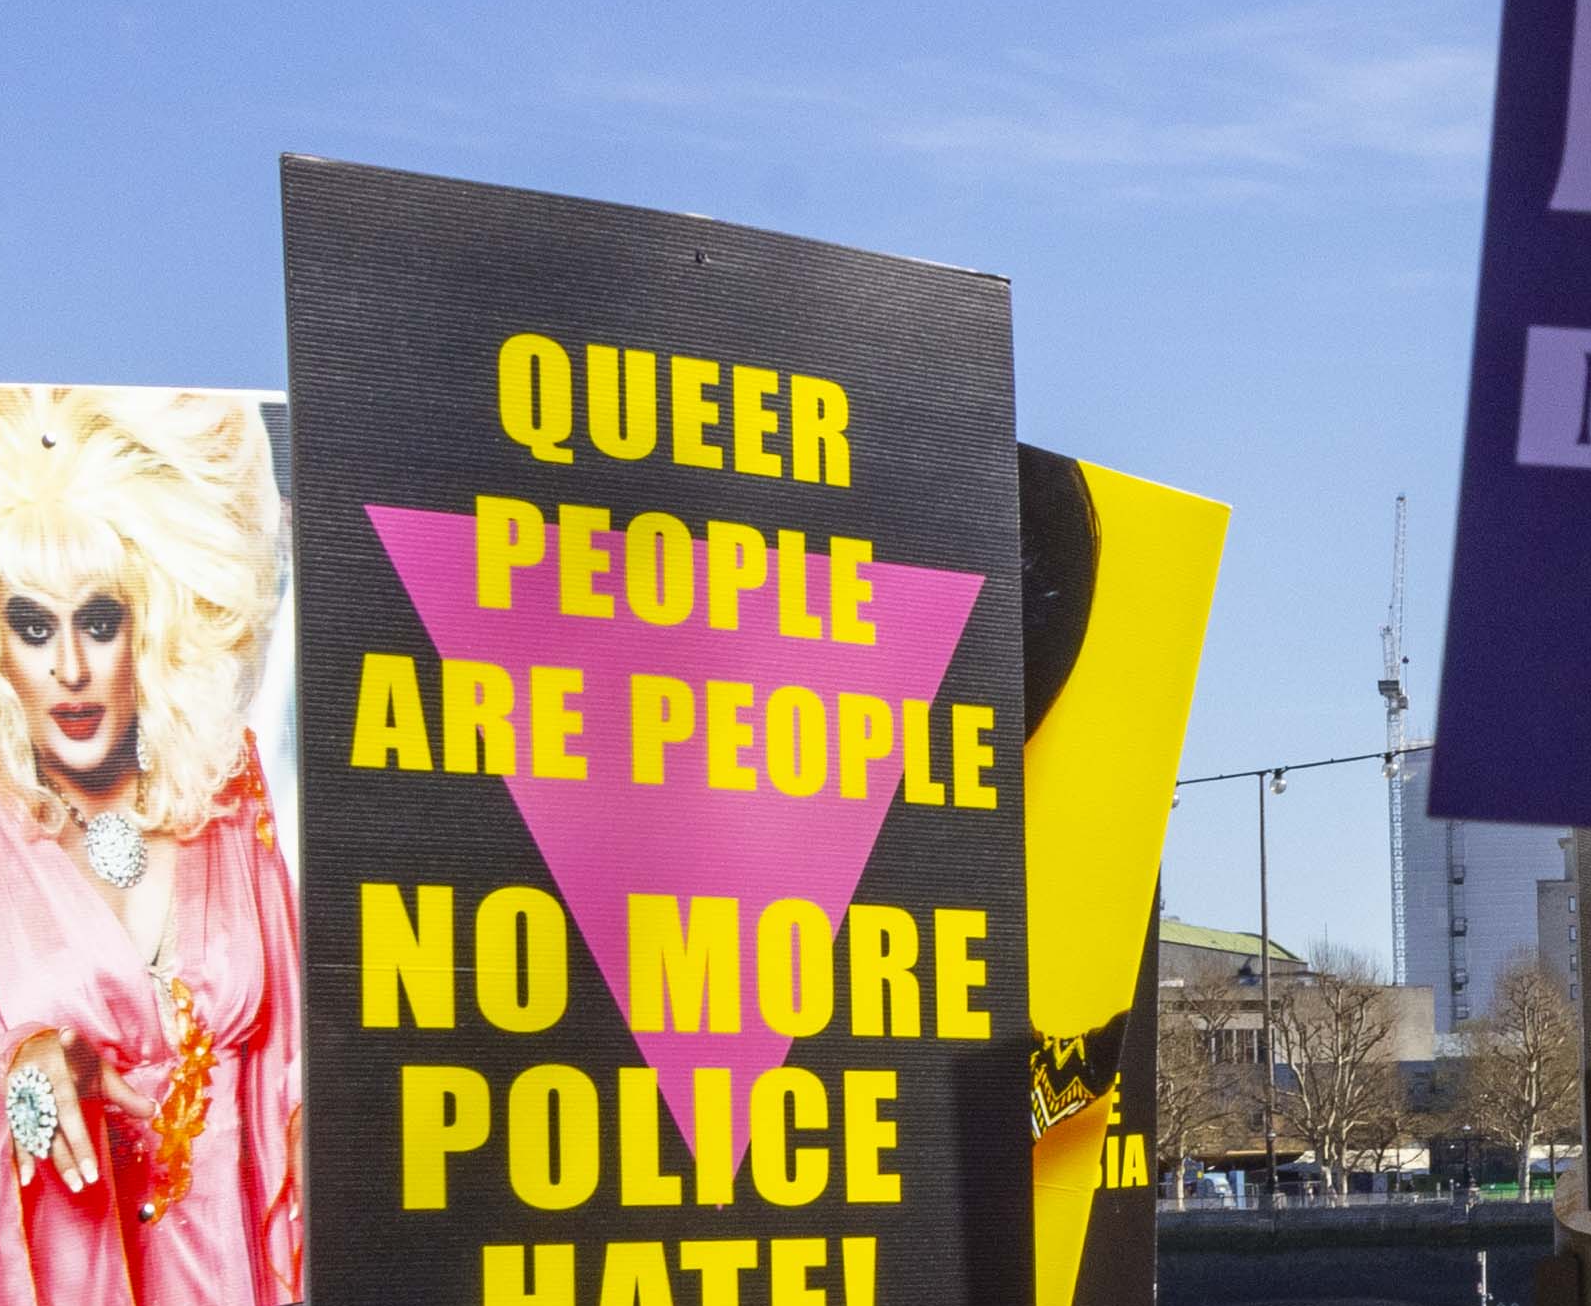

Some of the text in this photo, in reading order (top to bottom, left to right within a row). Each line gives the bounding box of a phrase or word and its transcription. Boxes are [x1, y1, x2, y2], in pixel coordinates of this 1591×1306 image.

[497, 332, 852, 488] QUEER
[474, 494, 874, 643] PEOPLE
[349, 652, 999, 810] ARE PEOPLE
[359, 881, 992, 1041] NO MORE
[399, 1062, 903, 1211] POLICE
[1093, 1134, 1149, 1189] IA
